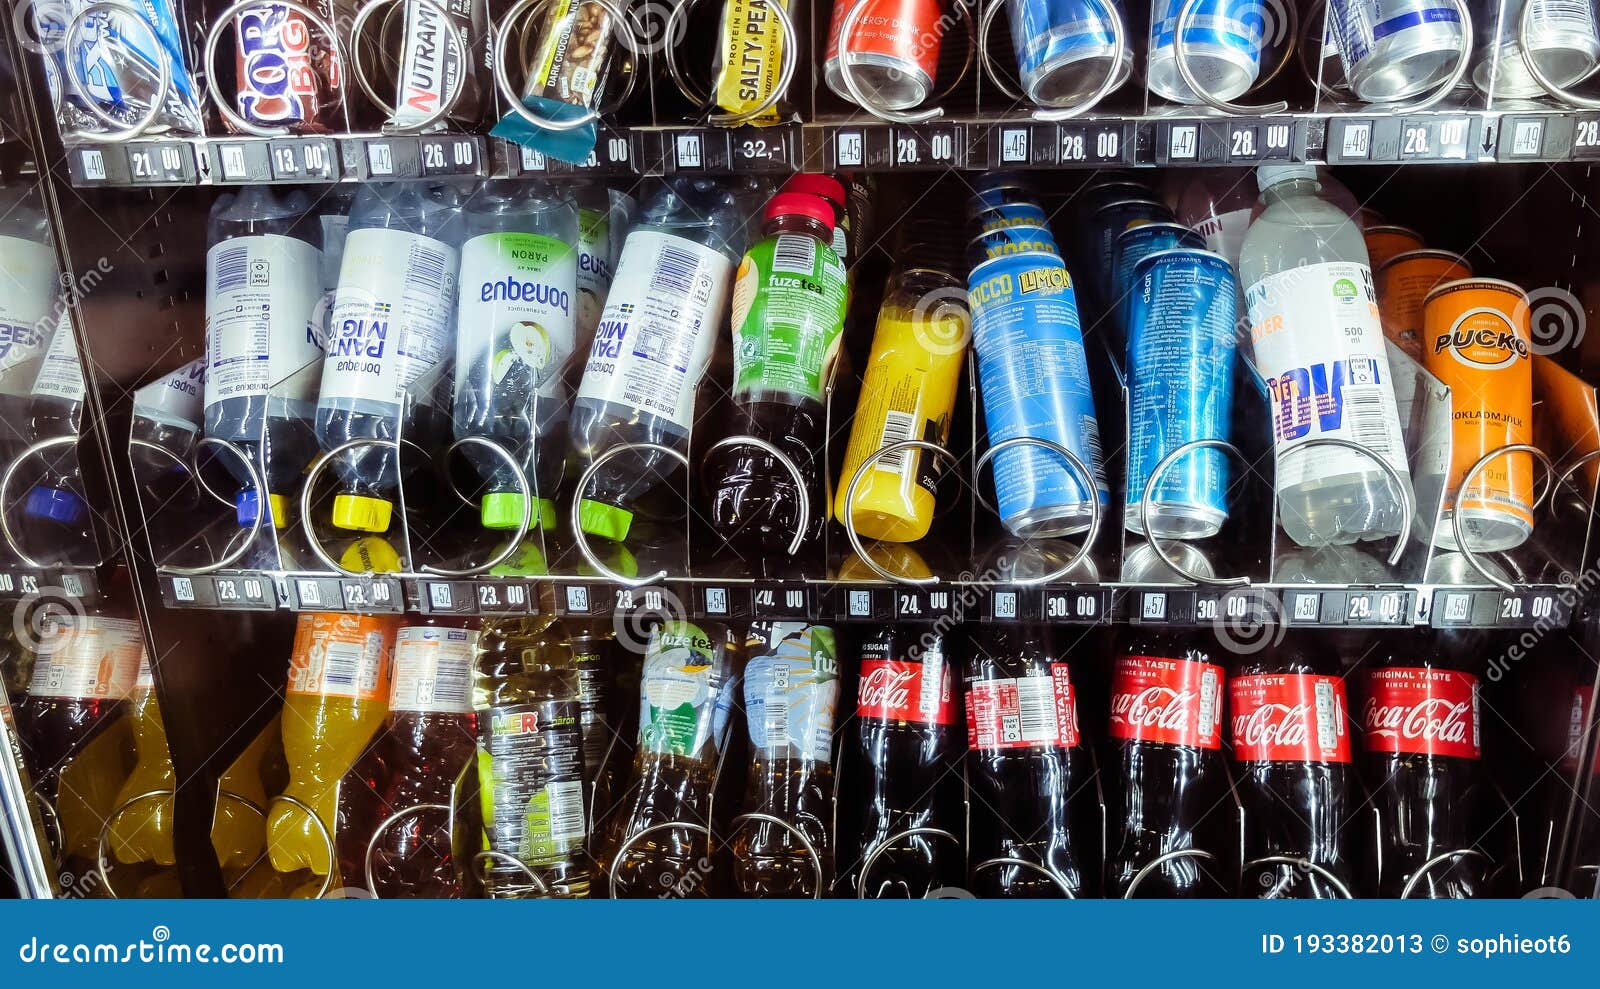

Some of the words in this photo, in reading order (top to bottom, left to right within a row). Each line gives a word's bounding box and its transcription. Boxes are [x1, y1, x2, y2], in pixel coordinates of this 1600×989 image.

[855, 15, 889, 26] NERGY
[729, 16, 741, 66] PROTEIN
[281, 18, 317, 97] BIG
[547, 62, 562, 87] DARK
[739, 41, 764, 101] SALTY
[840, 138, 861, 161] #45
[932, 135, 951, 160] 00
[1005, 134, 1025, 158] #46
[1097, 132, 1118, 158] 00
[1173, 132, 1195, 155] #47
[1344, 129, 1367, 151] #48
[1516, 126, 1538, 149] #49
[373, 148, 391, 171] #42
[454, 142, 473, 165] 00
[608, 139, 627, 162] 00
[680, 140, 700, 163] #44
[743, 141, 781, 160] 32,-
[768, 274, 823, 295] fuzetea
[1143, 273, 1152, 304] clean
[480, 275, 569, 317] bonaqua
[343, 319, 389, 340] MIG
[1344, 327, 1363, 336] 500
[1350, 336, 1361, 344] ml
[326, 338, 385, 359] PANT
[590, 339, 623, 359] PAN
[1434, 328, 1530, 361] PUCKO
[336, 359, 381, 376] bonaqua
[245, 578, 263, 599] 00
[302, 583, 320, 601] #51
[507, 585, 524, 604] 00
[569, 590, 588, 608] #53
[708, 591, 726, 610] #54
[851, 594, 869, 613] #55
[996, 592, 1015, 614] #56
[1077, 596, 1095, 616] 00
[1145, 596, 1164, 616] #57
[1227, 596, 1246, 617] 00
[1296, 596, 1315, 616] #58
[1532, 597, 1553, 617] 00
[660, 631, 713, 650] fuzetea
[1145, 660, 1177, 671] TASTE
[1054, 666, 1064, 695] MIG
[1062, 666, 1071, 701] IGEN
[1254, 677, 1285, 686] TASTE
[1372, 671, 1415, 680] ORIGINAL
[1418, 671, 1451, 682] TASTE
[491, 711, 539, 737] MER
[1058, 698, 1070, 744] PANTA
[1363, 697, 1471, 744] Coca-Cola
